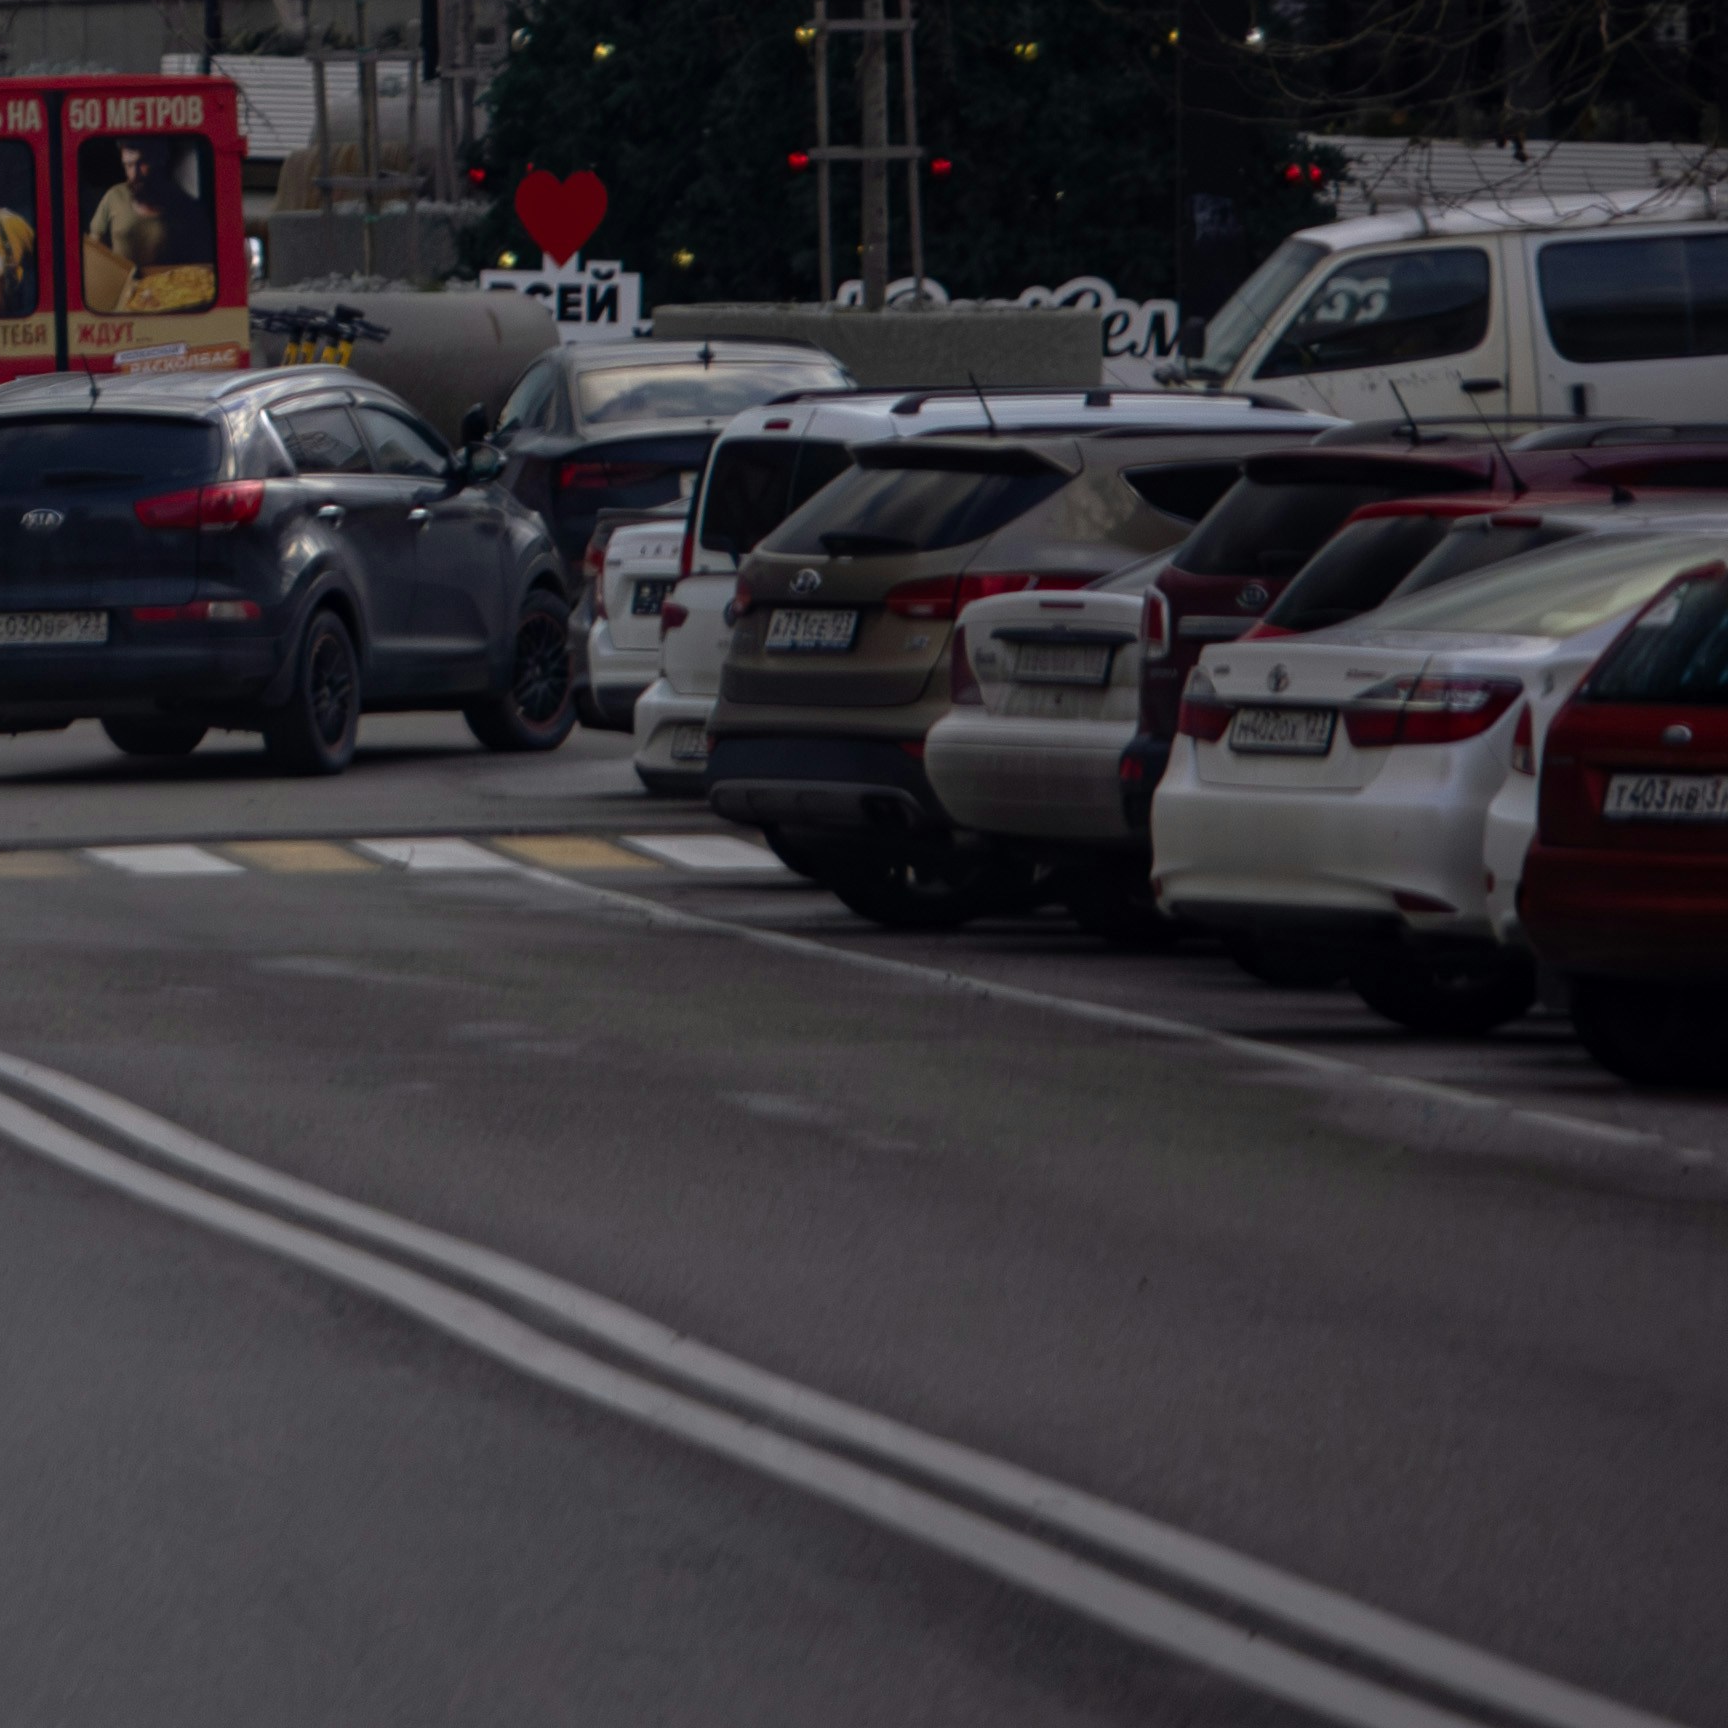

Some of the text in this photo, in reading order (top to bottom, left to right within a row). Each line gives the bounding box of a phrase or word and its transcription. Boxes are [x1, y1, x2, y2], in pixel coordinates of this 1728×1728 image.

[8, 100, 42, 132] НА
[69, 98, 100, 130] 50
[107, 96, 203, 129] МЕТРОВ
[0, 324, 48, 346] ТЕБЯ
